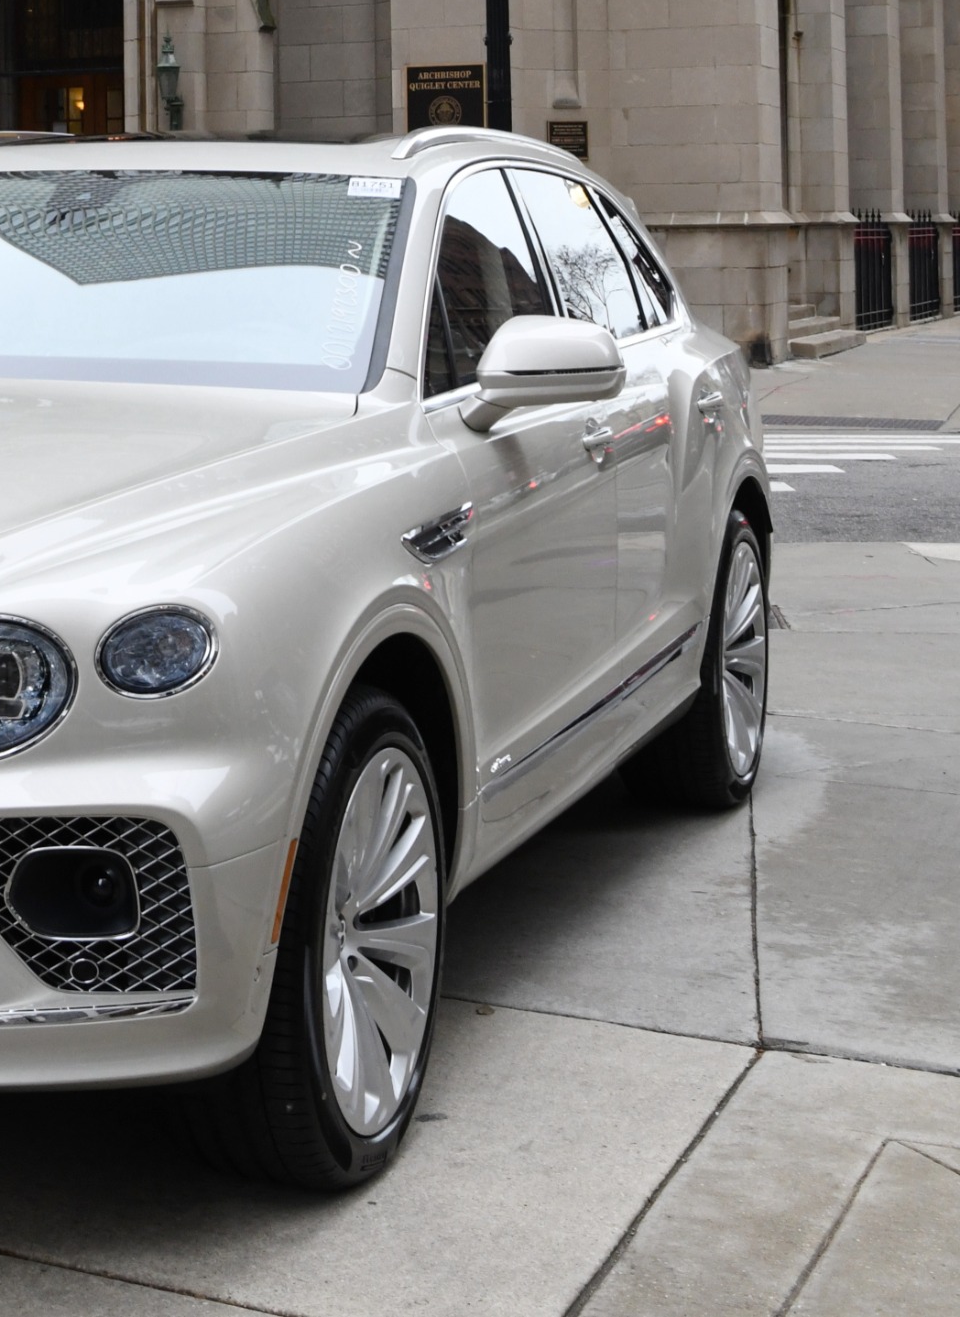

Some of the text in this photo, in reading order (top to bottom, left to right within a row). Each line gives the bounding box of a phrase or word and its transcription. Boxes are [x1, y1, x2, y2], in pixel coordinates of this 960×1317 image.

[418, 70, 472, 80] ARCHBISHOP
[409, 80, 481, 91] QUIGLEY CENTER
